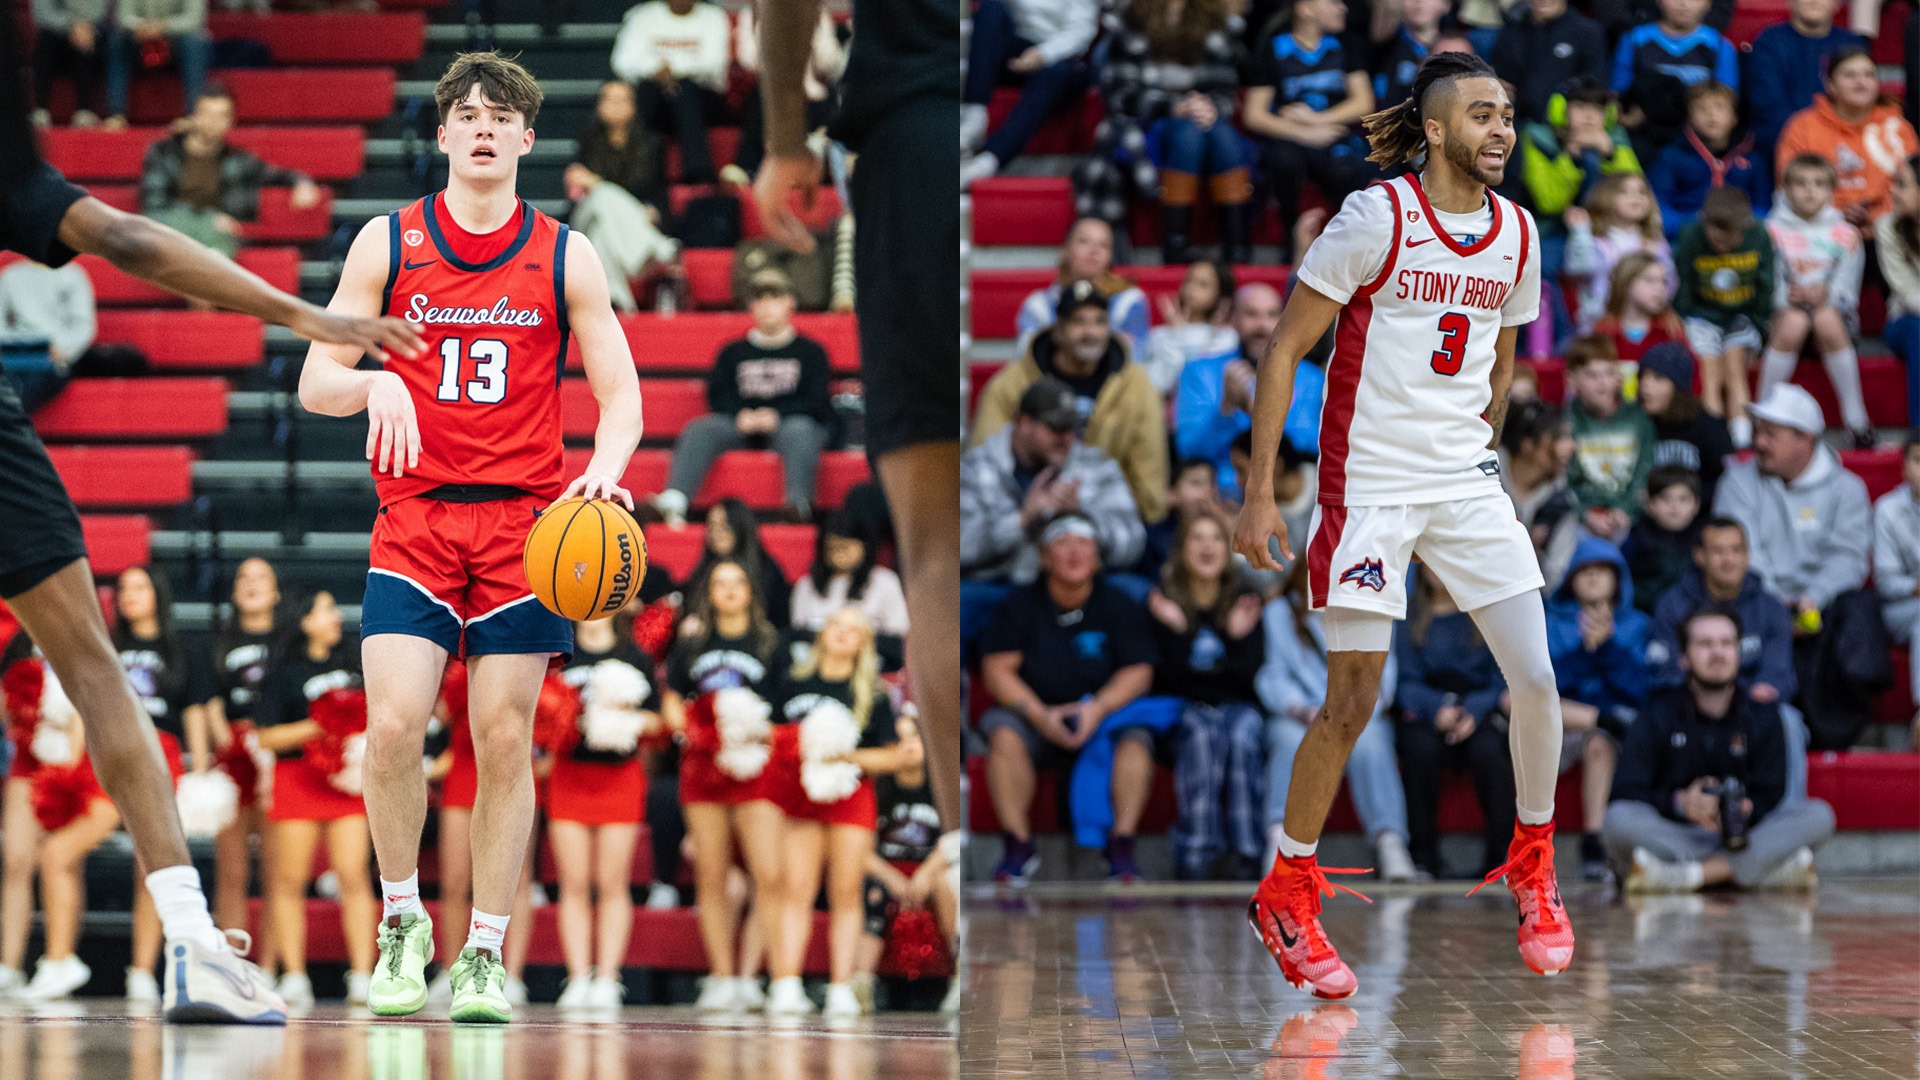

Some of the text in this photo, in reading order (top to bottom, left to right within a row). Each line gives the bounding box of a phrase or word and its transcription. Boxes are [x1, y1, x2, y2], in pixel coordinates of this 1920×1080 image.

[404, 293, 543, 327] Seawolves
[1396, 269, 1461, 304] STONY
[436, 337, 509, 404] 13
[1430, 311, 1471, 376] 3
[601, 532, 632, 612] Wilson
